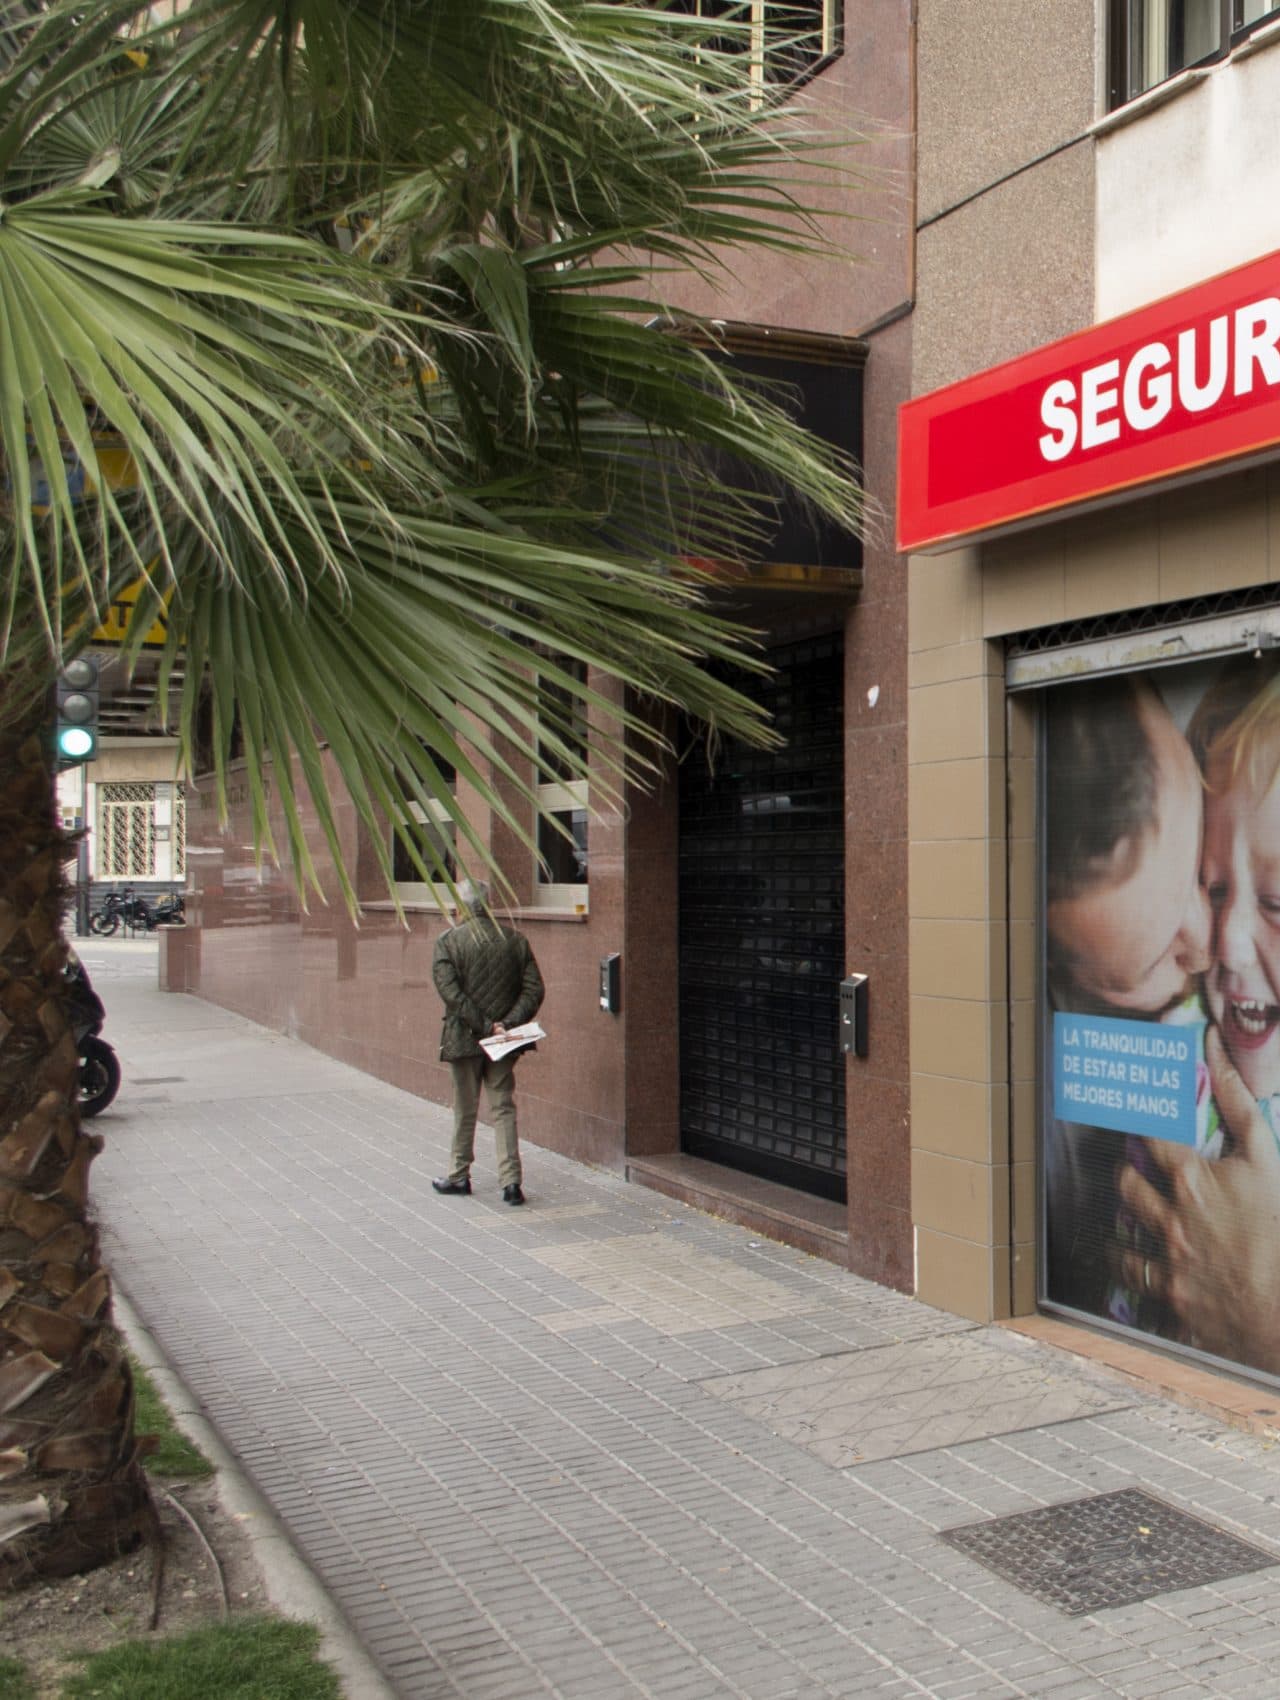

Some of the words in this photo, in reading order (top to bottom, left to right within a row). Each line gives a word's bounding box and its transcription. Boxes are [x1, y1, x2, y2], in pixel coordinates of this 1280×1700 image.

[1063, 1027, 1080, 1046] LA
[1083, 1029, 1188, 1061] TRANQUILIDAD
[1063, 1054, 1081, 1074] DE
[1084, 1058, 1126, 1081] ESTAR
[1130, 1064, 1148, 1085] EN
[1152, 1067, 1181, 1089] LAS
[1063, 1082, 1122, 1109] MEJORES
[1127, 1093, 1179, 1119] MANOS
